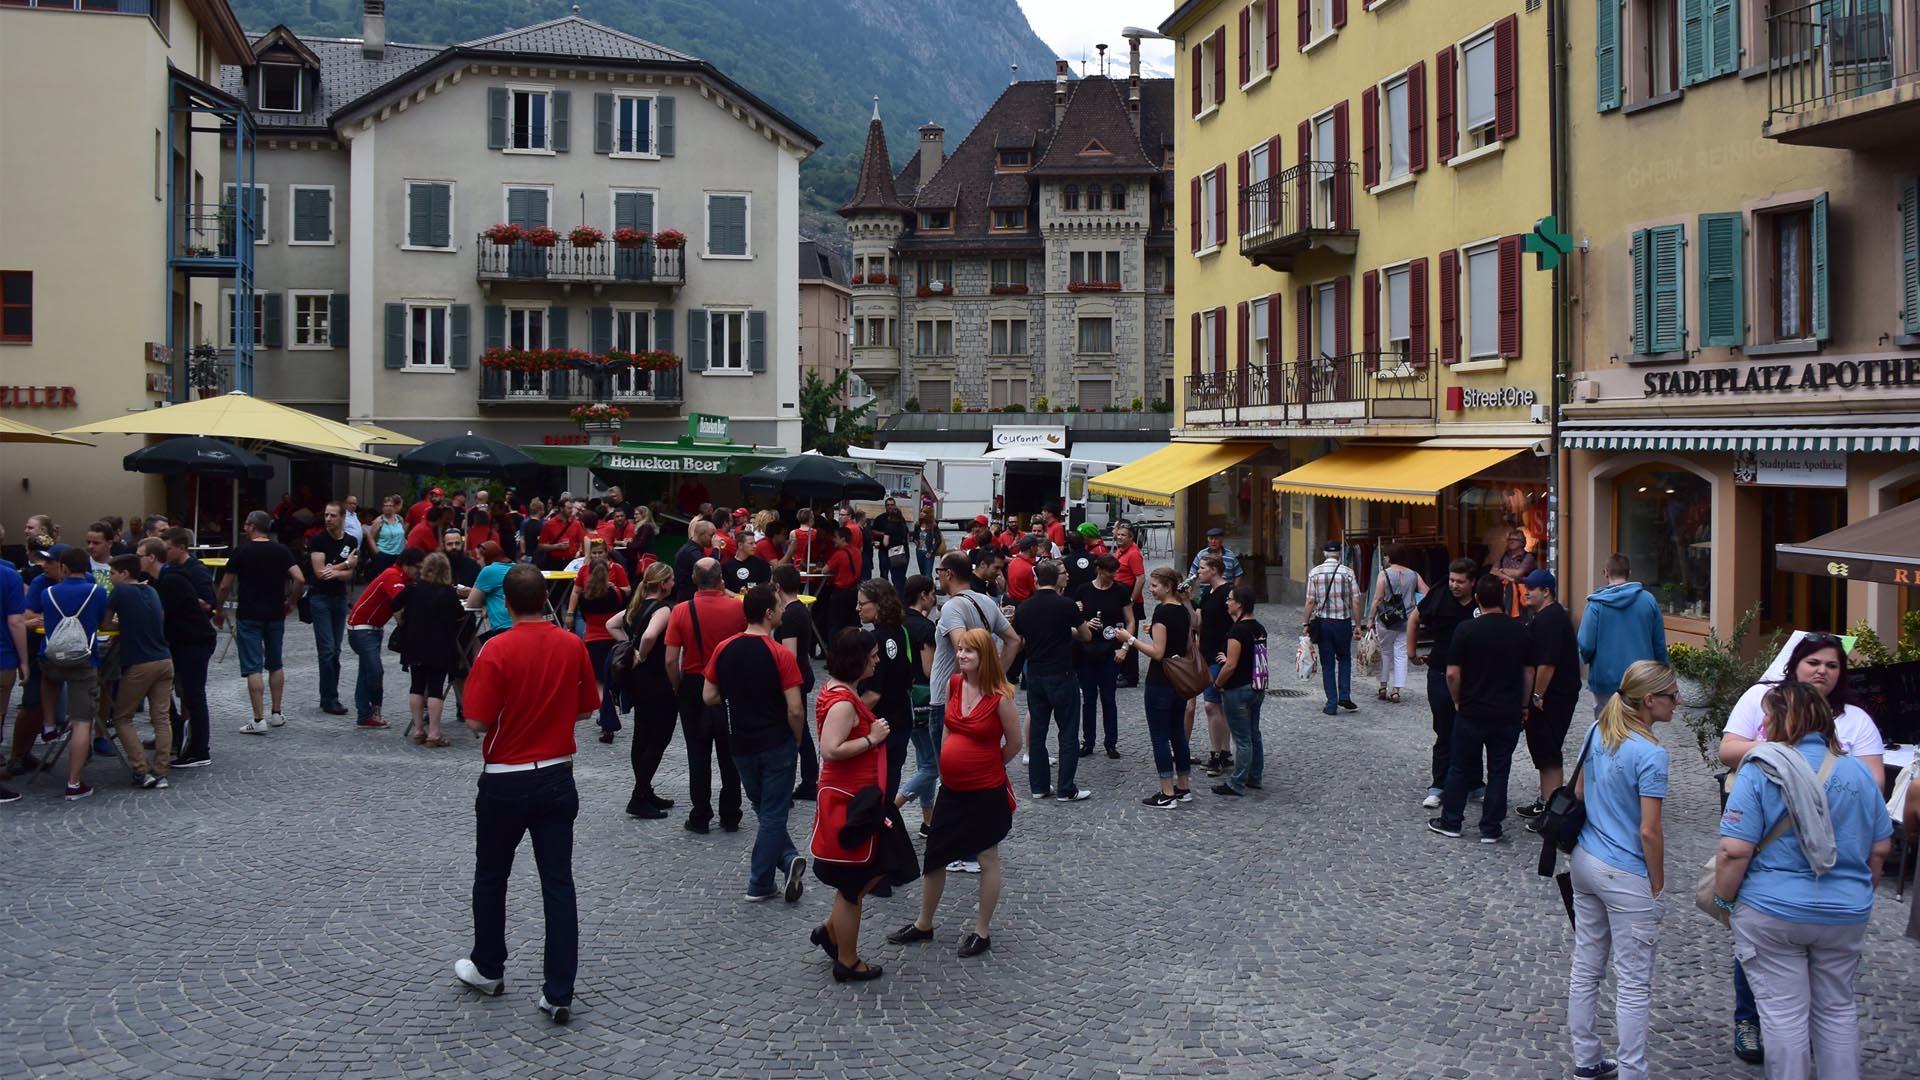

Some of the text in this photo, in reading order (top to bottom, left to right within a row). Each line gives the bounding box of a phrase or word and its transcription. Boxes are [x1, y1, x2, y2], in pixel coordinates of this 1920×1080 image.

[1643, 357, 1920, 397] STADTPLATZ APOTHE
[609, 454, 721, 472] Heineken Beer
[1759, 458, 1843, 472] Stadtplatz Apotheke
